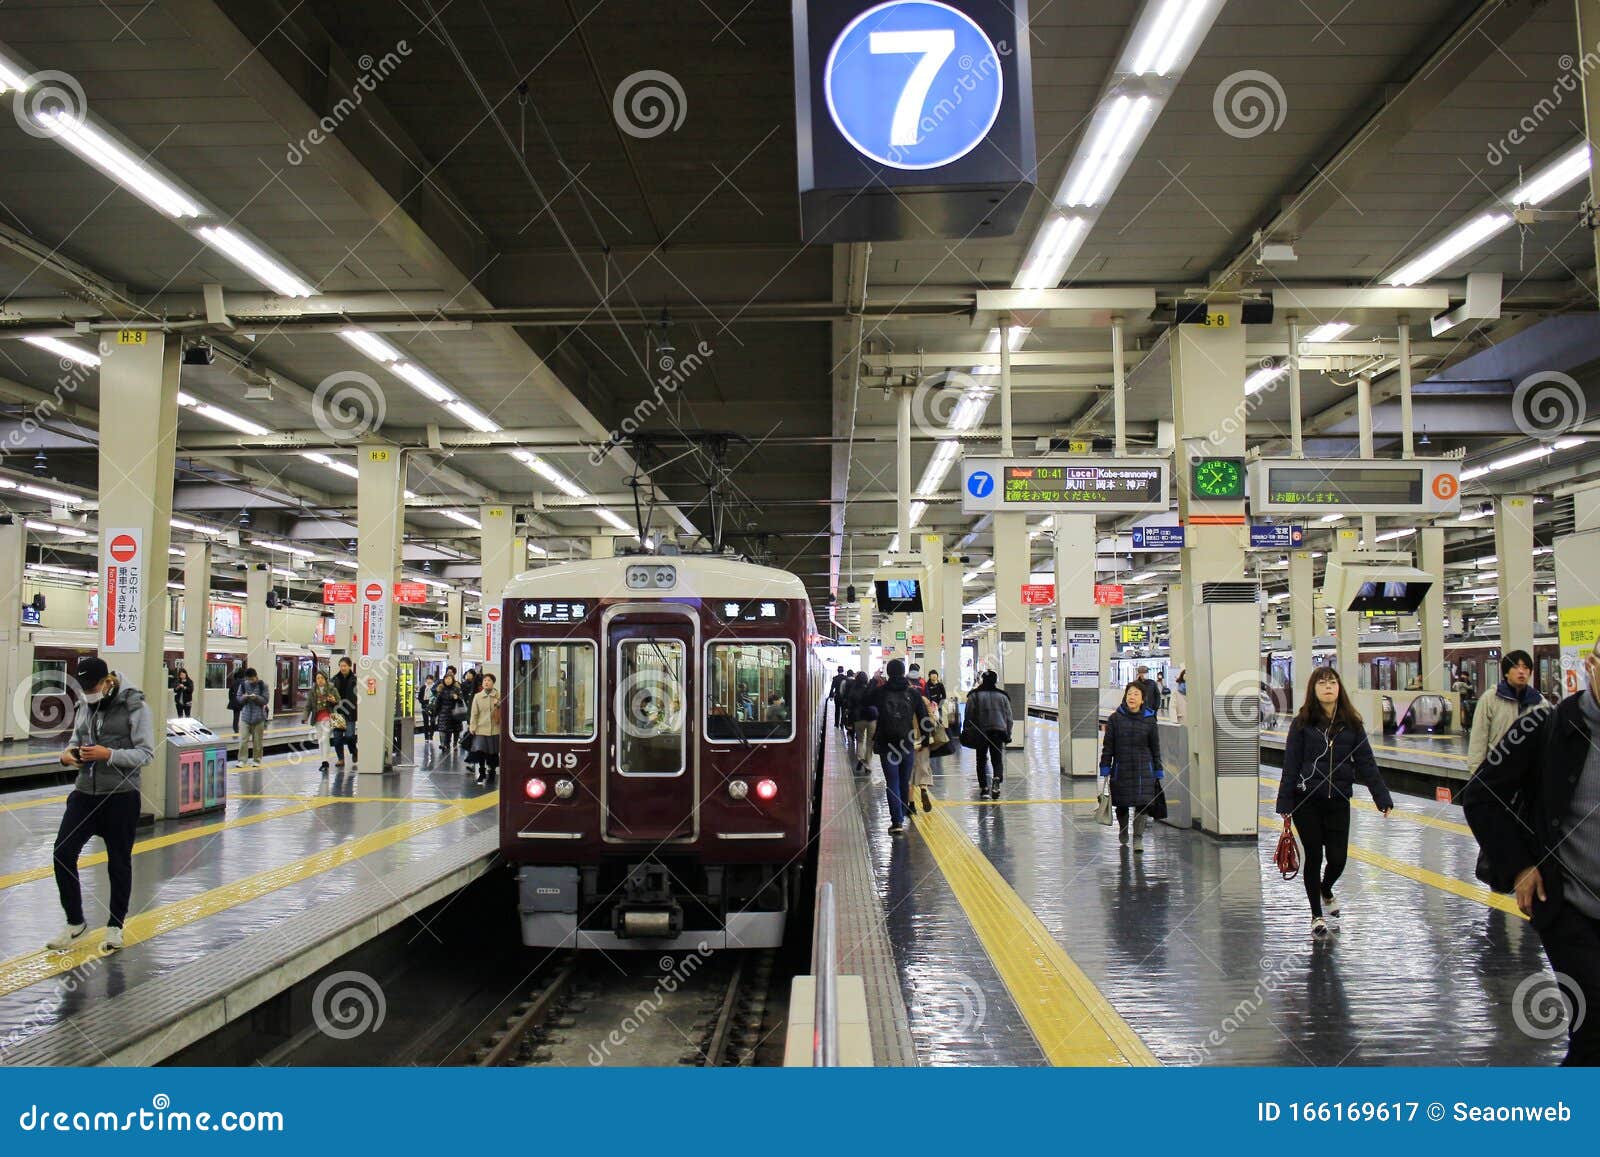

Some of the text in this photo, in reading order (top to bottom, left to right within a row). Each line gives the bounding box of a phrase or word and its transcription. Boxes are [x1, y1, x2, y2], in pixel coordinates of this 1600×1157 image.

[869, 29, 955, 146] 7
[121, 331, 142, 343] H-8
[1037, 468, 1062, 479] 10:41
[1071, 469, 1095, 478] Local
[1098, 468, 1158, 479] Kobe-sannomiya
[973, 475, 989, 495] 7
[1437, 477, 1452, 496] 6
[1270, 492, 1339, 503] お願いします。
[117, 567, 128, 632] 乗車できません
[128, 567, 139, 632] このホームから
[522, 603, 585, 619] 神戸三宮
[724, 603, 776, 617] 普通
[527, 752, 578, 769] 7019
